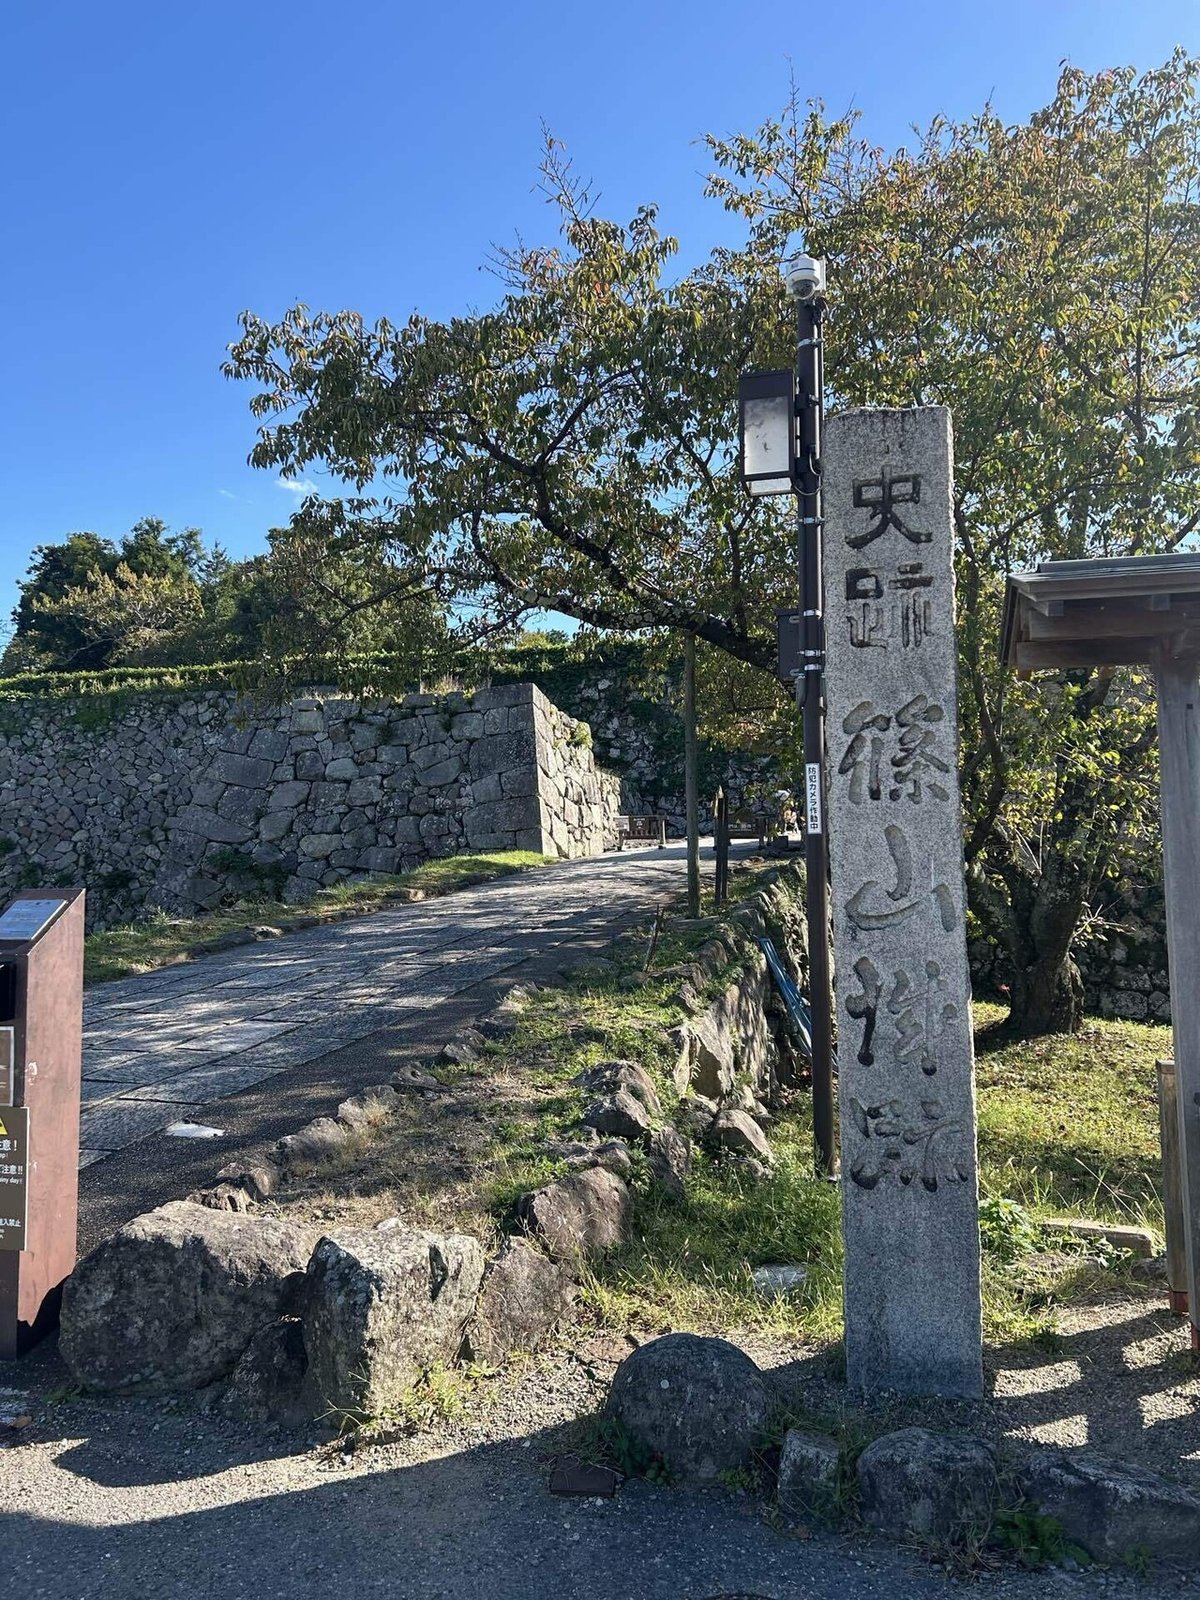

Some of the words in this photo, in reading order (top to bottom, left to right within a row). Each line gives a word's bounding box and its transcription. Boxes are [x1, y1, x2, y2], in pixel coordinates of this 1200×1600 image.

[808, 767, 819, 830] 防犯カメラ作動中
